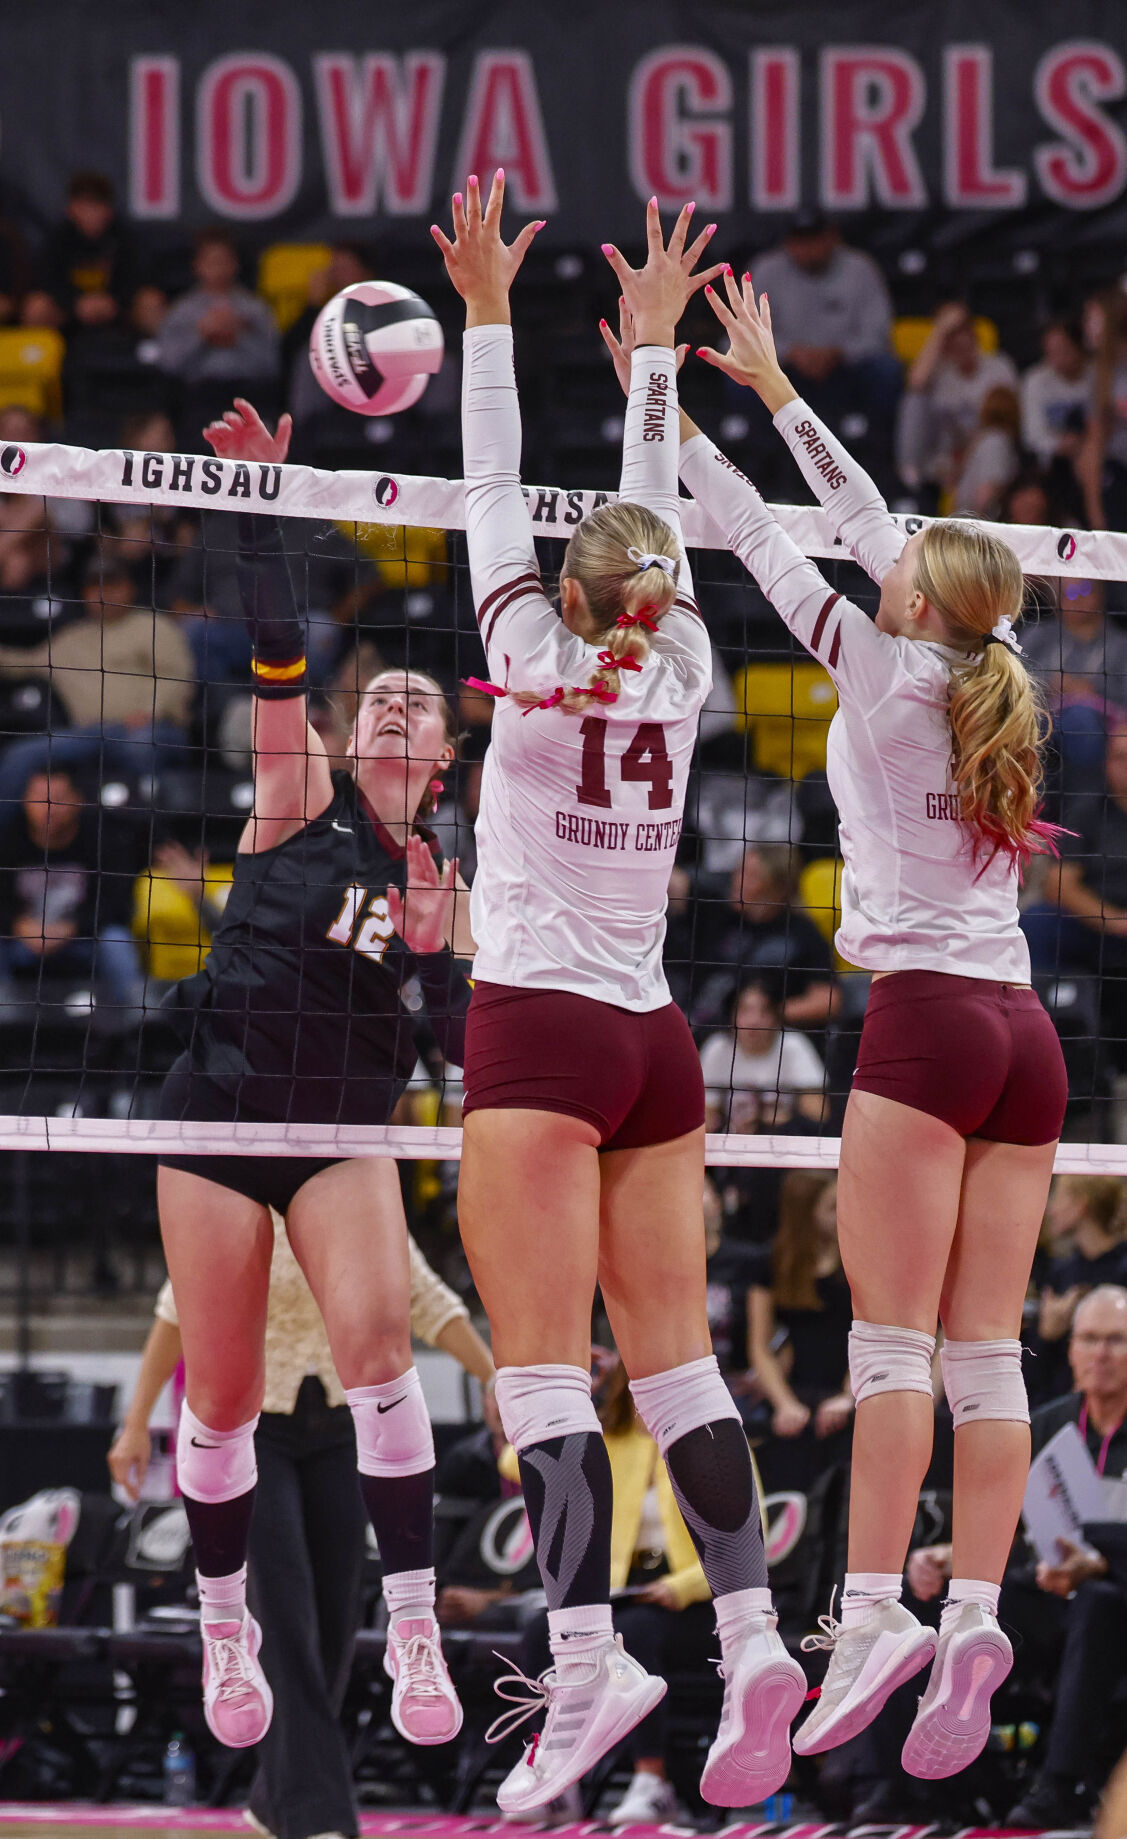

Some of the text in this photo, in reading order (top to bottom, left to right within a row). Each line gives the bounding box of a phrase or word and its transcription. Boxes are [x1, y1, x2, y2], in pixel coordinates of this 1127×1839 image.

[128, 38, 1127, 219] IOWA GIRLS
[642, 372, 669, 443] SPARTANS
[121, 450, 283, 501] IGHSAU
[794, 419, 848, 491] SPARTANS
[576, 715, 674, 810] 14
[555, 810, 629, 851] GRUNDY
[326, 881, 396, 964] 12
